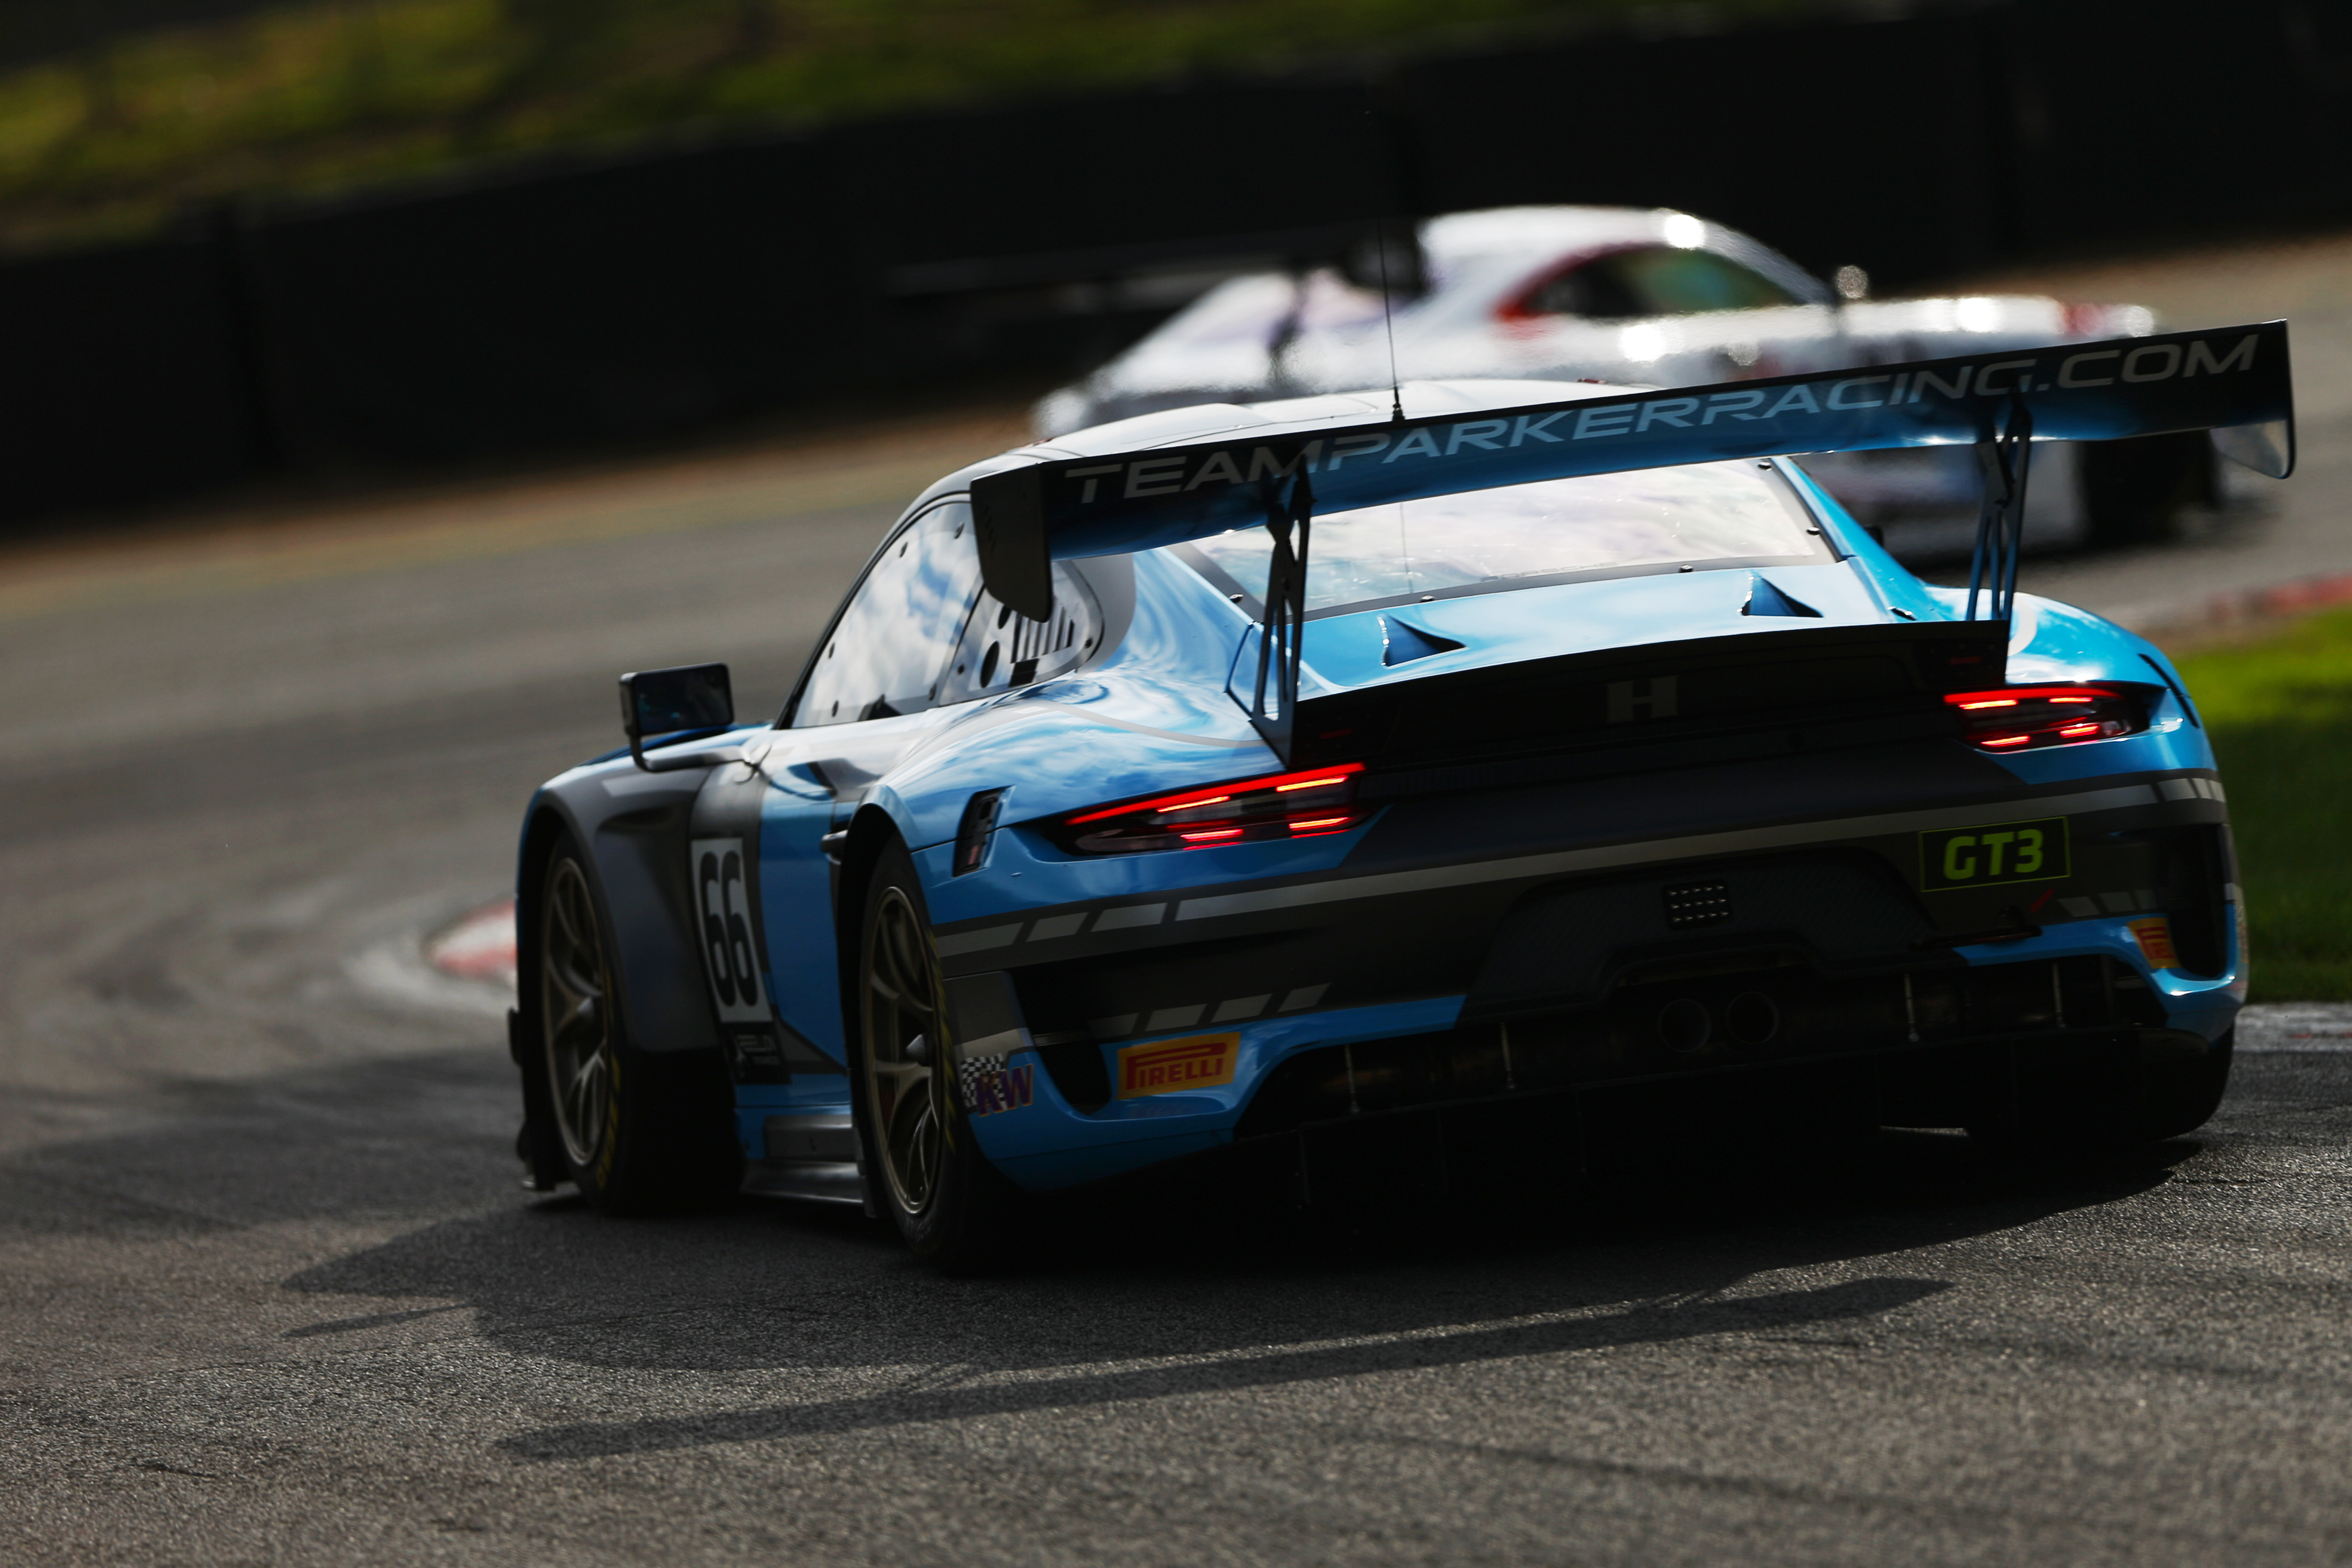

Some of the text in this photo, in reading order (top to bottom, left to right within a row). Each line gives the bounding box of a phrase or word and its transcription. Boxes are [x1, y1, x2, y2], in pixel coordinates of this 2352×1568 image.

[1064, 334, 2260, 504] TEAMPARKERRACING.COM
[1606, 675, 1678, 724] H
[1943, 829, 2043, 880] GT3
[700, 851, 757, 1006] 66
[975, 1063, 1034, 1117] KW
[1127, 1042, 1226, 1090] PIRELLI
